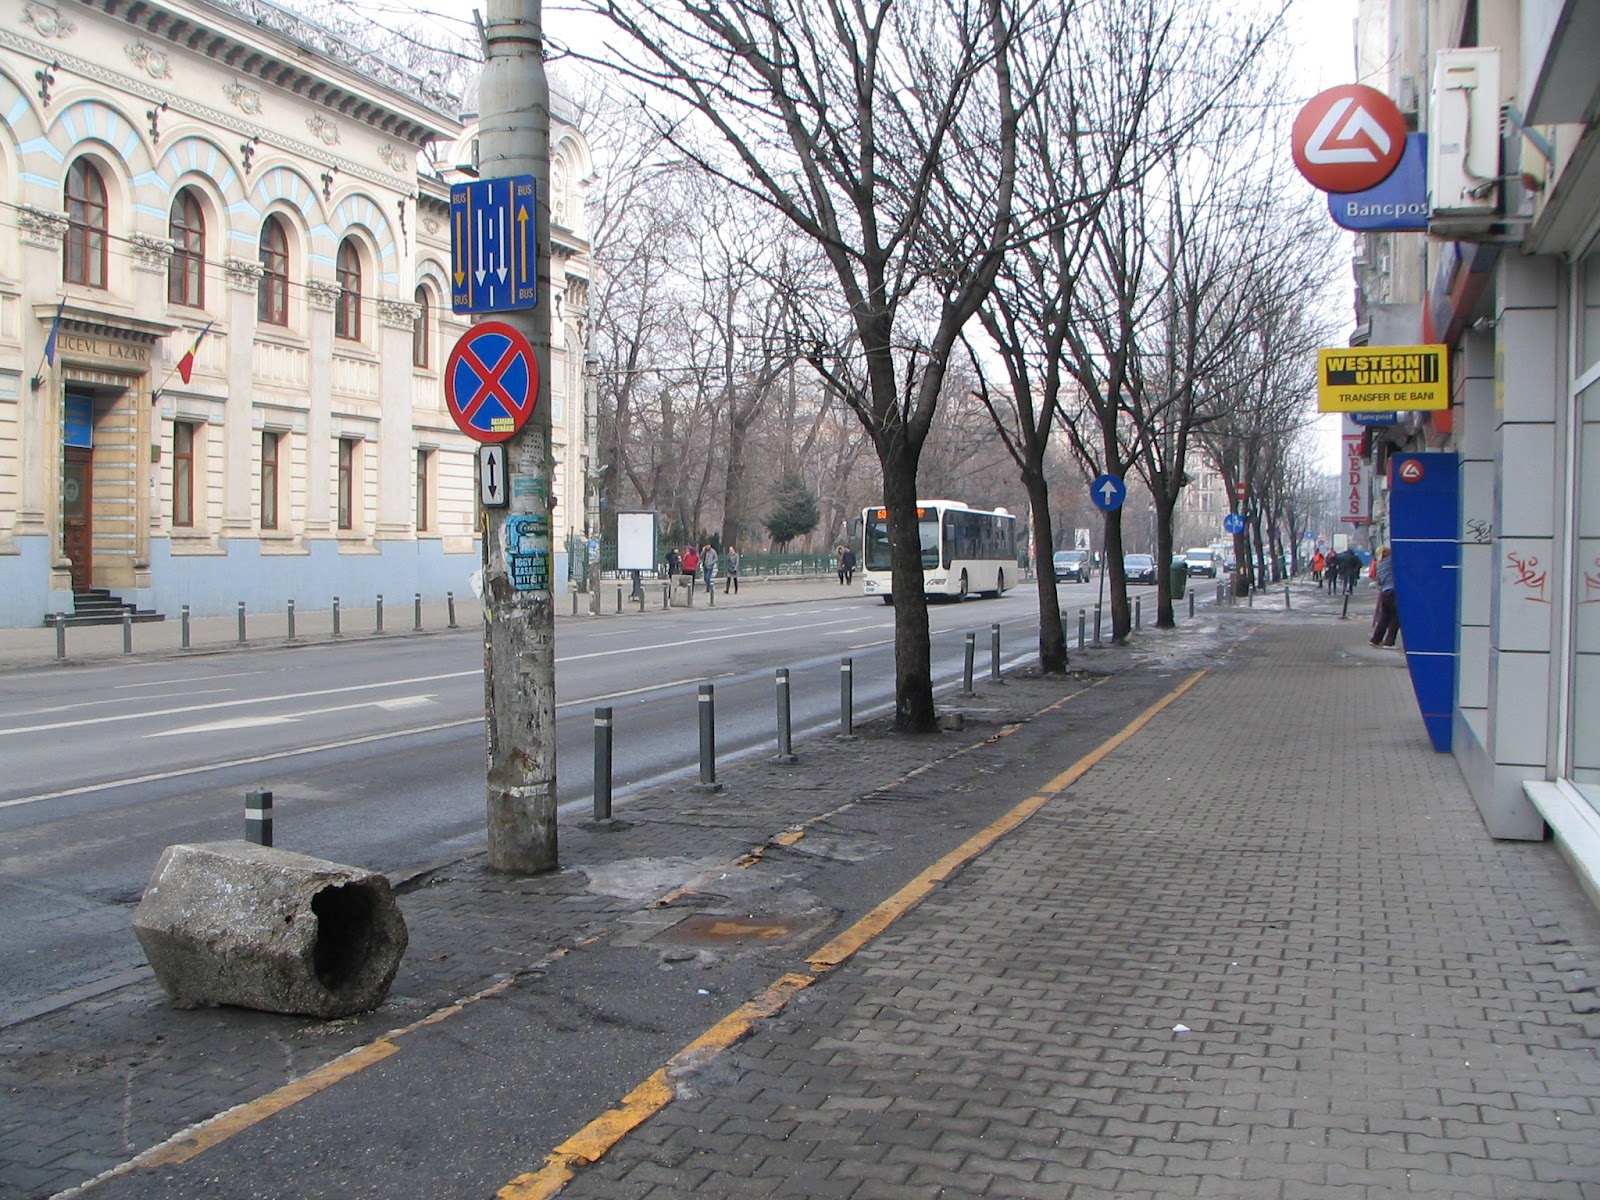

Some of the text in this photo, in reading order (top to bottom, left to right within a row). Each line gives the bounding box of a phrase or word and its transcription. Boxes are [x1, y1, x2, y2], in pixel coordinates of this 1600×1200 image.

[517, 185, 532, 196] BUS
[453, 193, 467, 204] BUS
[1347, 202, 1428, 219] Bancpos
[454, 294, 468, 306] BUS
[519, 288, 534, 300] BUS
[57, 336, 146, 361] LICEVL LAZAR
[1327, 355, 1420, 372] WESTERN
[1355, 370, 1420, 385] UNION
[1339, 392, 1434, 403] TRANSFER DE BANI
[1347, 443, 1362, 515] MEDAS
